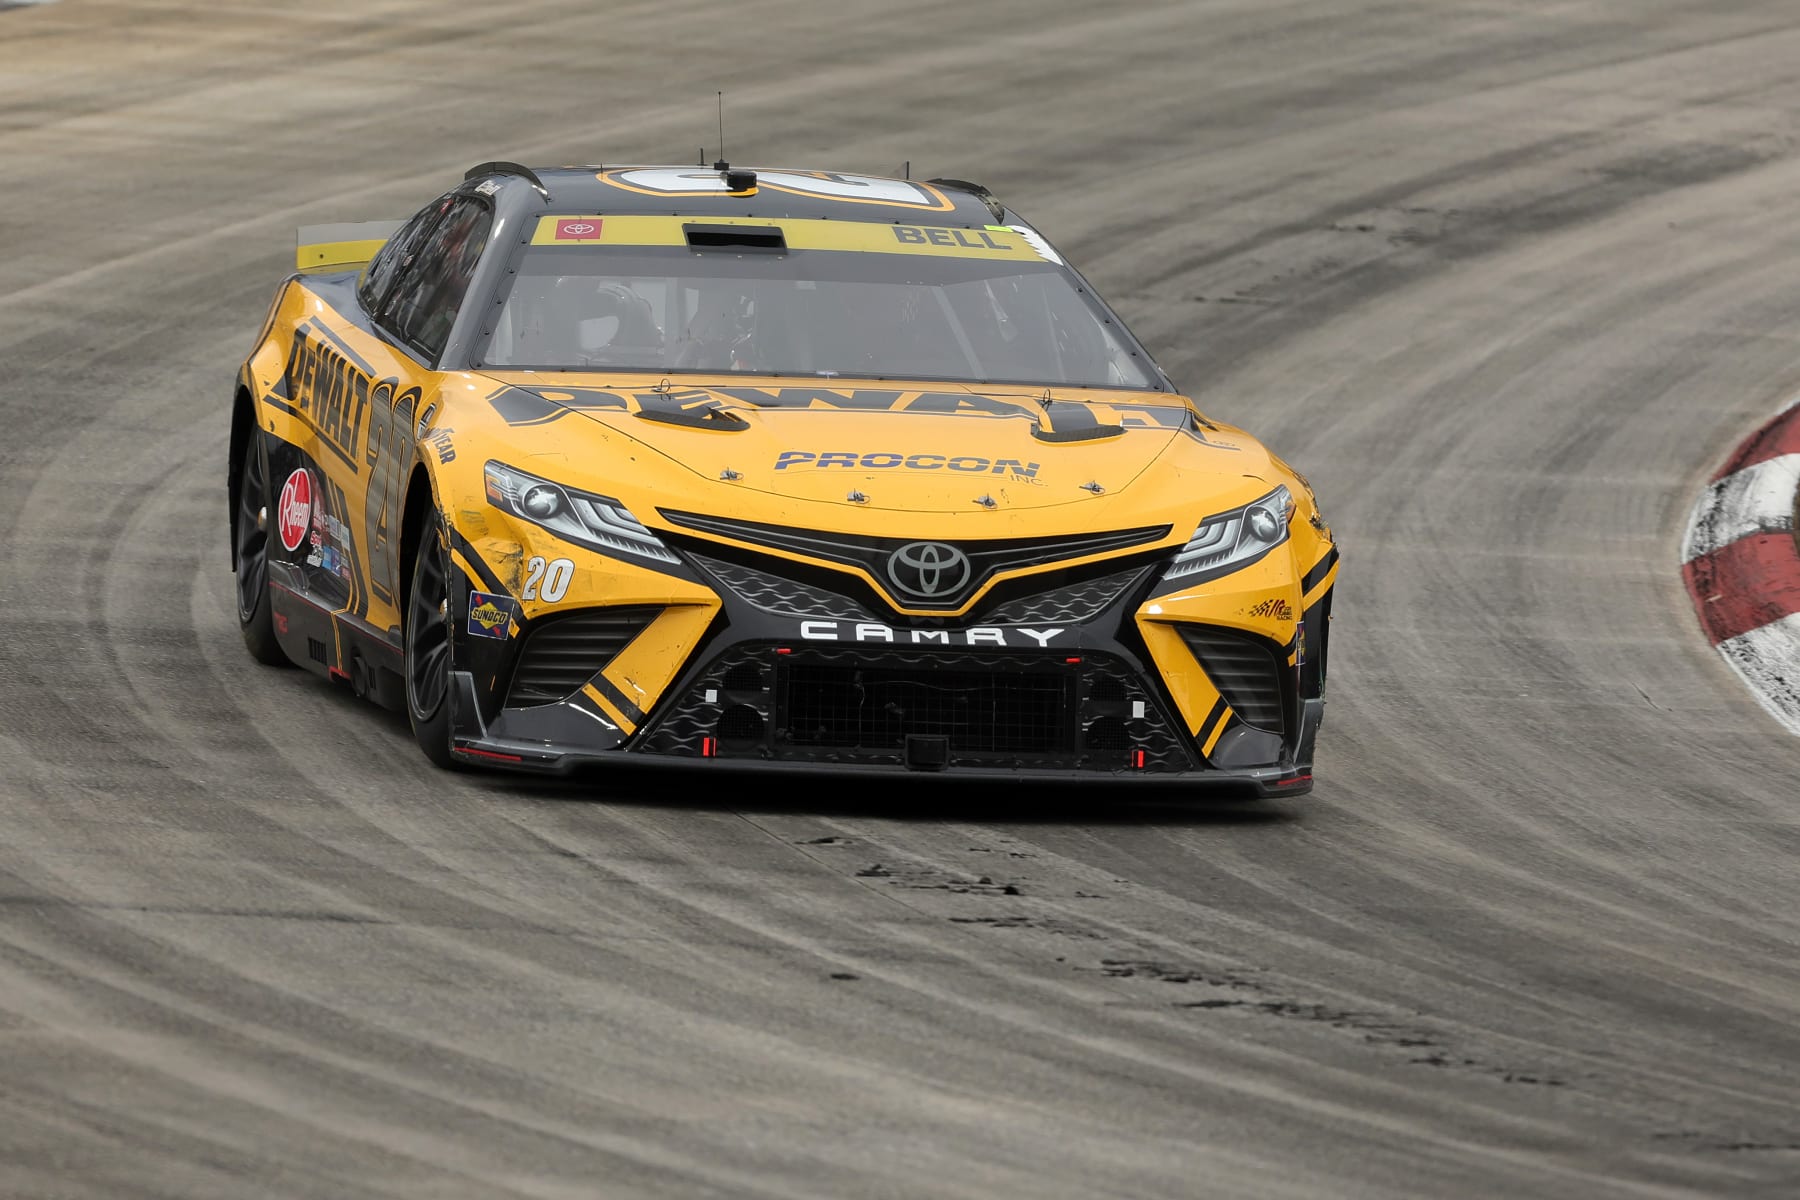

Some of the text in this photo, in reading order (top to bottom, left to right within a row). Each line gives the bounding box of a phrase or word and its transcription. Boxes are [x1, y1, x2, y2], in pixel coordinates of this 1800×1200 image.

[892, 226, 1012, 250] BELL
[271, 323, 370, 460] DEWALT
[774, 452, 1040, 477] PROCON
[1010, 475, 1048, 487] INC.
[282, 471, 309, 537] Rheem
[522, 556, 575, 604] 20
[473, 609, 508, 624] SUNOCO
[801, 621, 1065, 647] CAMRY
